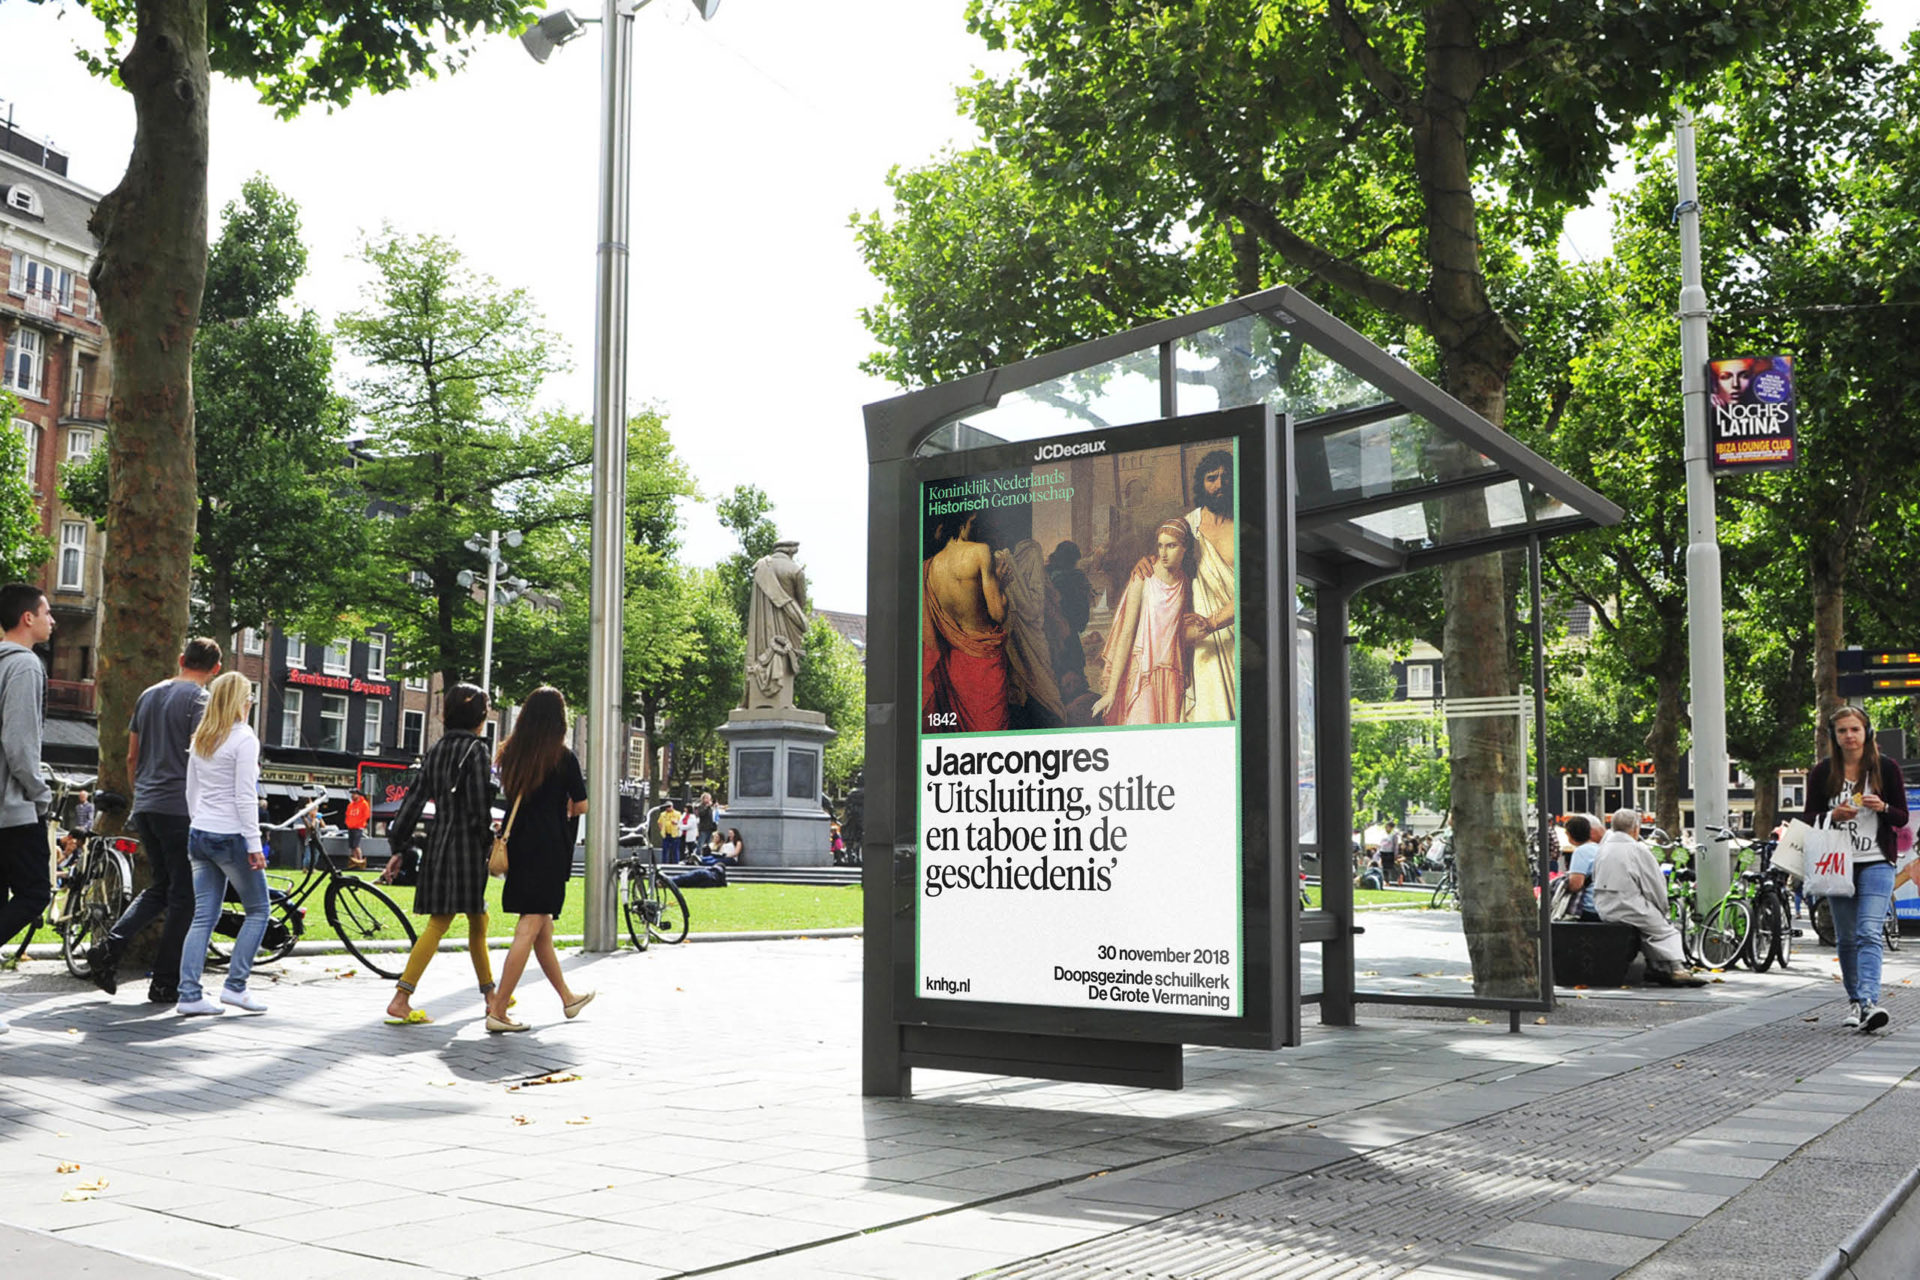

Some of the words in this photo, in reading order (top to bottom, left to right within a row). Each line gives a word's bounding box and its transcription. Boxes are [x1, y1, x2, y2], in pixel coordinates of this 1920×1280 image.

[1716, 402, 1790, 426] NOCHES
[1720, 416, 1781, 437] LATINA
[1033, 440, 1107, 461] JCDecaux
[1715, 442, 1737, 454] IBIZA
[1737, 440, 1771, 452] LOUNGE
[1771, 439, 1792, 451] CLUB
[928, 479, 991, 501] Koninklijk
[992, 468, 1066, 493] Nederlands
[928, 496, 990, 516] Historisch
[991, 485, 1075, 508] Genootschap
[289, 667, 350, 692] Rembrandt
[350, 677, 392, 696] Square
[927, 711, 958, 727] 1842
[926, 745, 1110, 781] Jaarcongres
[1098, 775, 1175, 812] stilte
[925, 827, 960, 852] en
[965, 817, 1047, 852] taboe
[1052, 817, 1084, 852] in
[1089, 816, 1128, 852] de
[1097, 944, 1117, 960] 30
[1119, 947, 1191, 963] november
[1193, 948, 1230, 965] 2018
[926, 976, 971, 994] knhg.nl
[1054, 965, 1153, 986] Doopsgezinde
[1154, 971, 1230, 990] schuilkerk
[1088, 985, 1108, 1001] De
[1109, 986, 1150, 1003] Grote
[1151, 988, 1230, 1011] Vermaning
